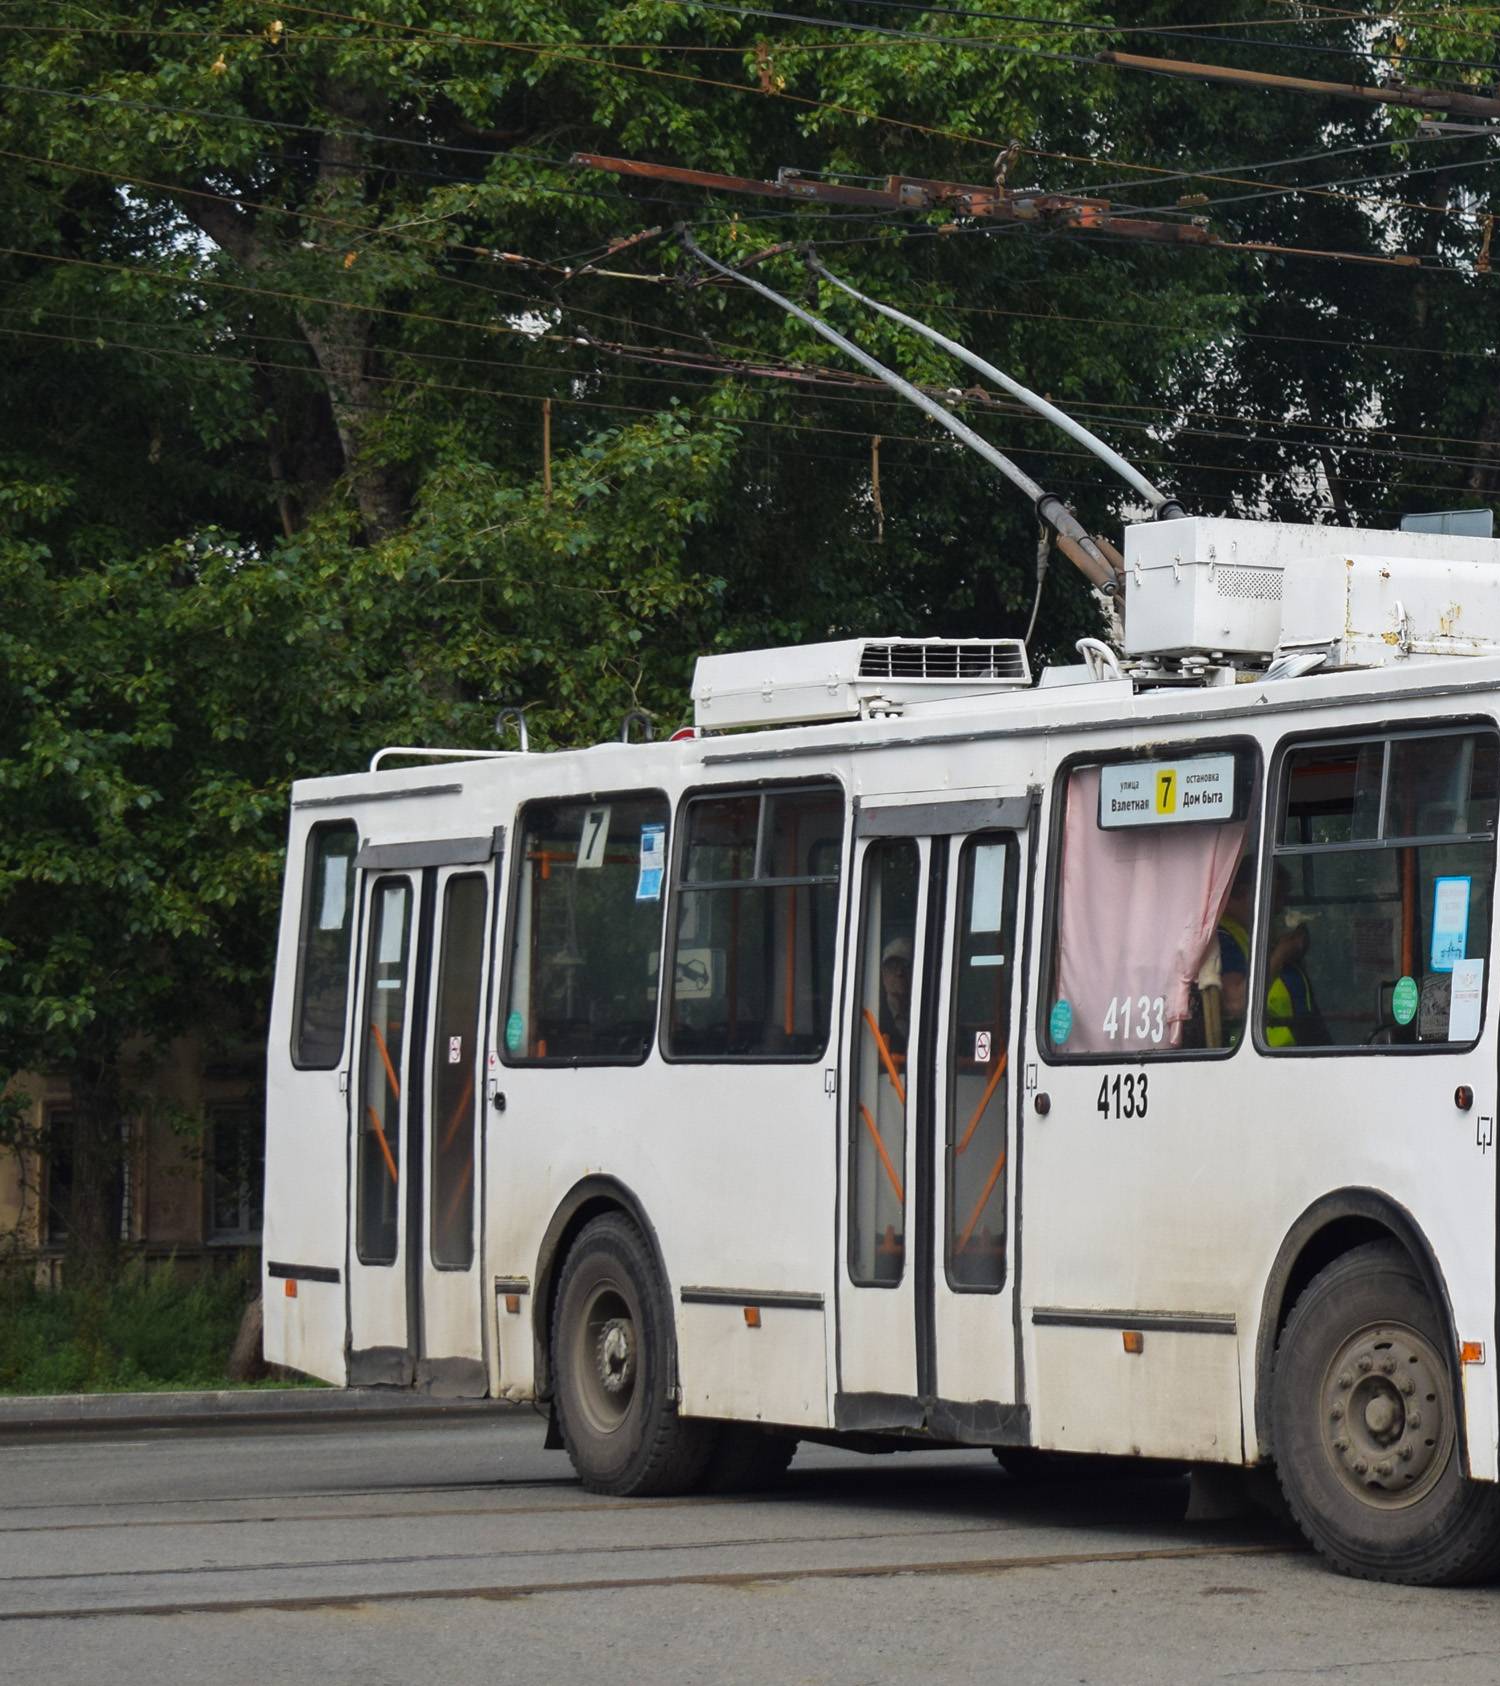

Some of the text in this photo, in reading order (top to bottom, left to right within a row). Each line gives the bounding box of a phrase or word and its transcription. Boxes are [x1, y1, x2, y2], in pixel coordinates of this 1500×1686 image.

[1120, 780, 1139, 792] улица
[1186, 772, 1219, 784] остановка
[1161, 777, 1172, 808] 7
[1183, 790, 1223, 808] Дом быта
[1111, 799, 1149, 812] Взлетная
[586, 811, 605, 860] 7
[1103, 995, 1164, 1043] 4133
[1097, 1073, 1148, 1120] 4133
